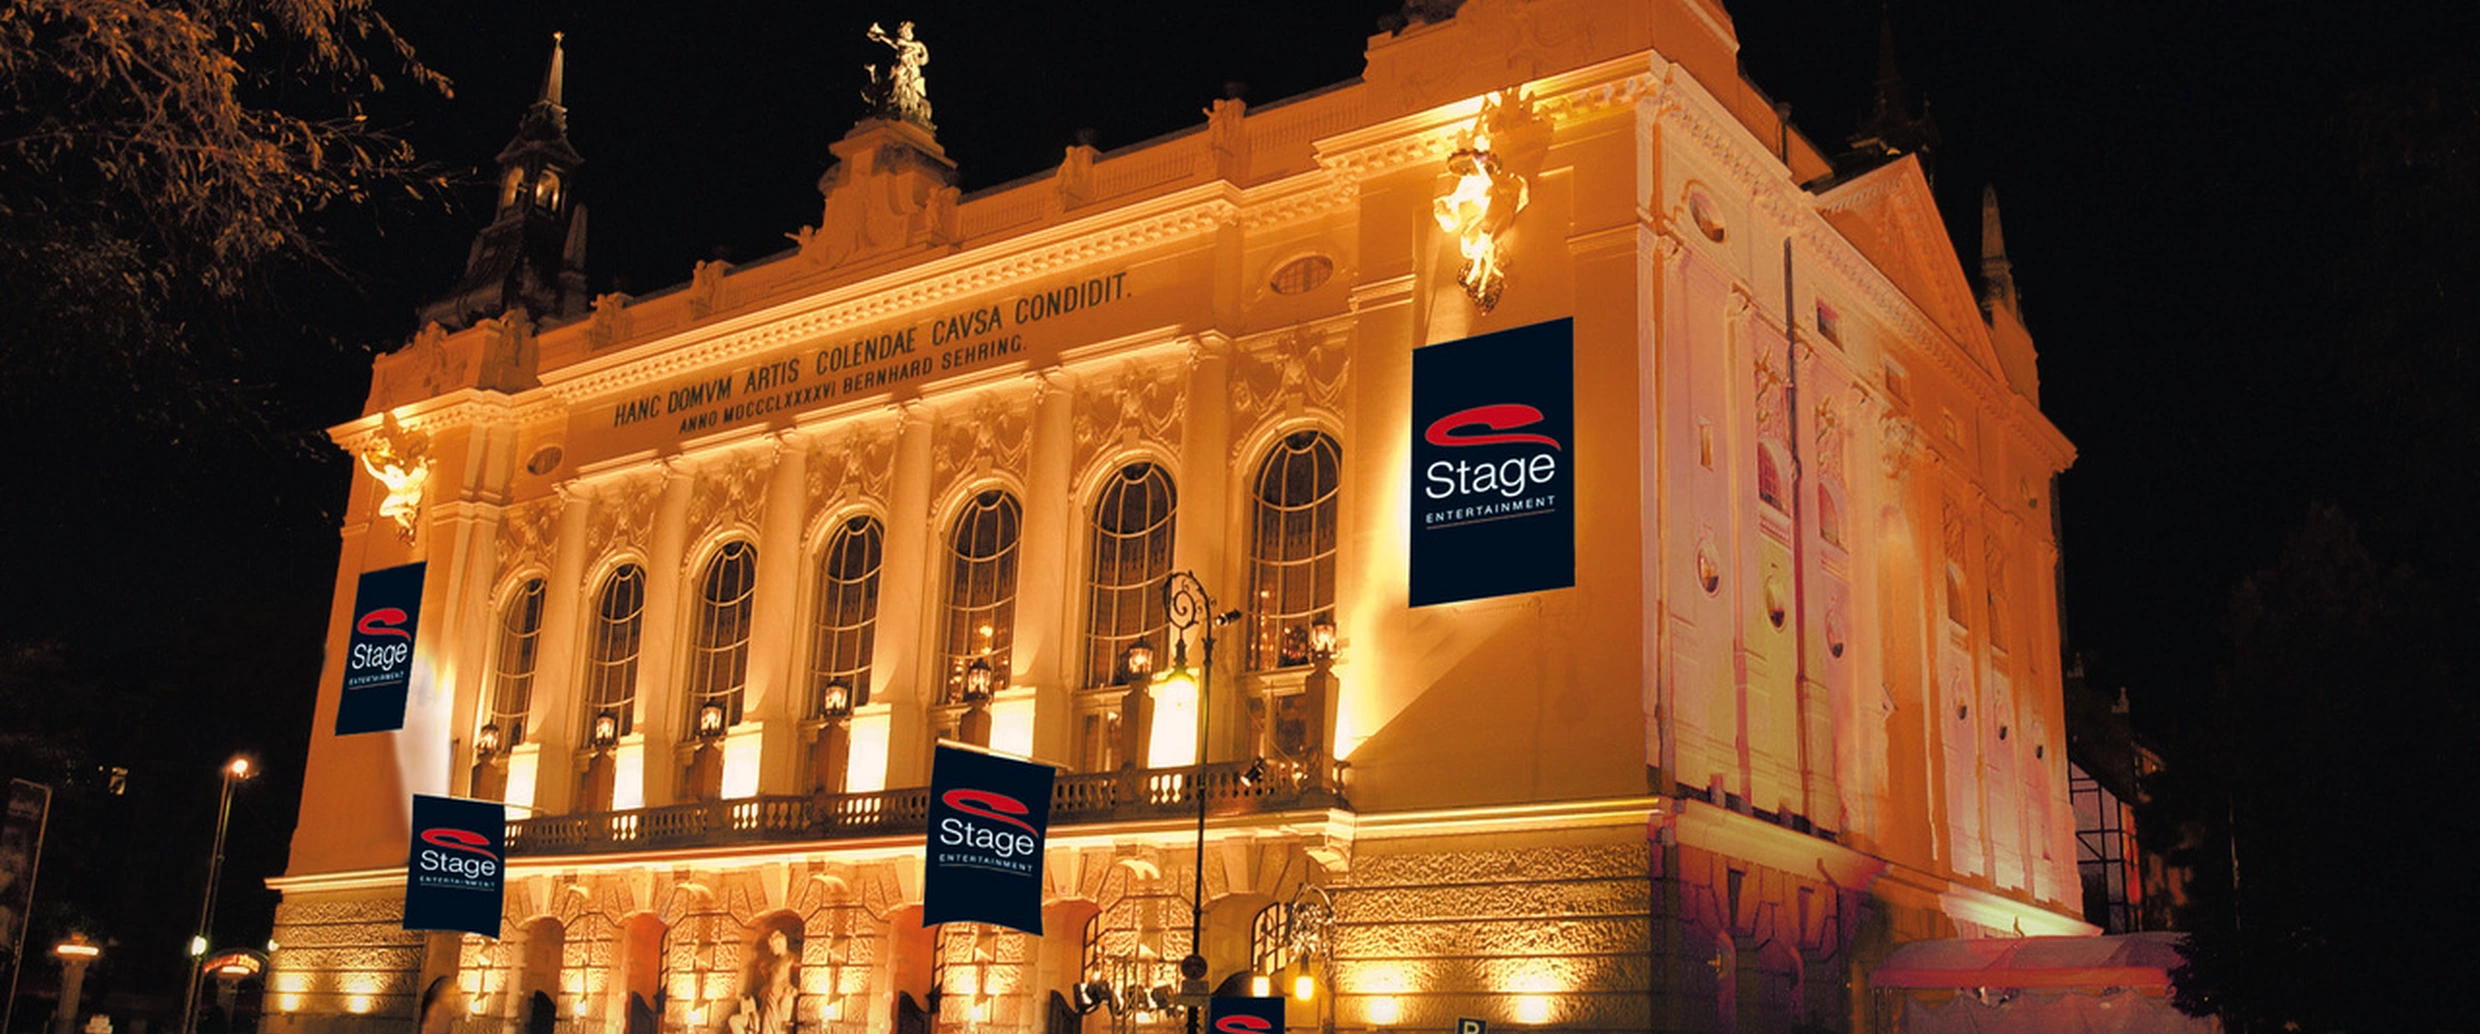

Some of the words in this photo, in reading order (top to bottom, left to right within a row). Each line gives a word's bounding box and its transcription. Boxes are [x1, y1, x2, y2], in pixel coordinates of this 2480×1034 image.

[613, 396, 661, 428] HANC
[667, 376, 731, 414] DOMVM
[743, 358, 800, 394] ARTIS
[816, 327, 917, 376] COLENDAE
[931, 306, 1003, 346] CAVSA
[1014, 272, 1133, 324] CONDIDIT.
[679, 414, 718, 434] ANNO
[842, 356, 933, 395] BERNHARD
[941, 334, 1028, 371] SEHRING.
[1425, 453, 1556, 499] Stage
[1426, 495, 1556, 524] ENTERTAINMENT
[352, 642, 408, 671] Stage
[940, 817, 1035, 858] Stage
[420, 849, 496, 879] Stage
[939, 854, 1033, 872] ENTERTAINMENT
